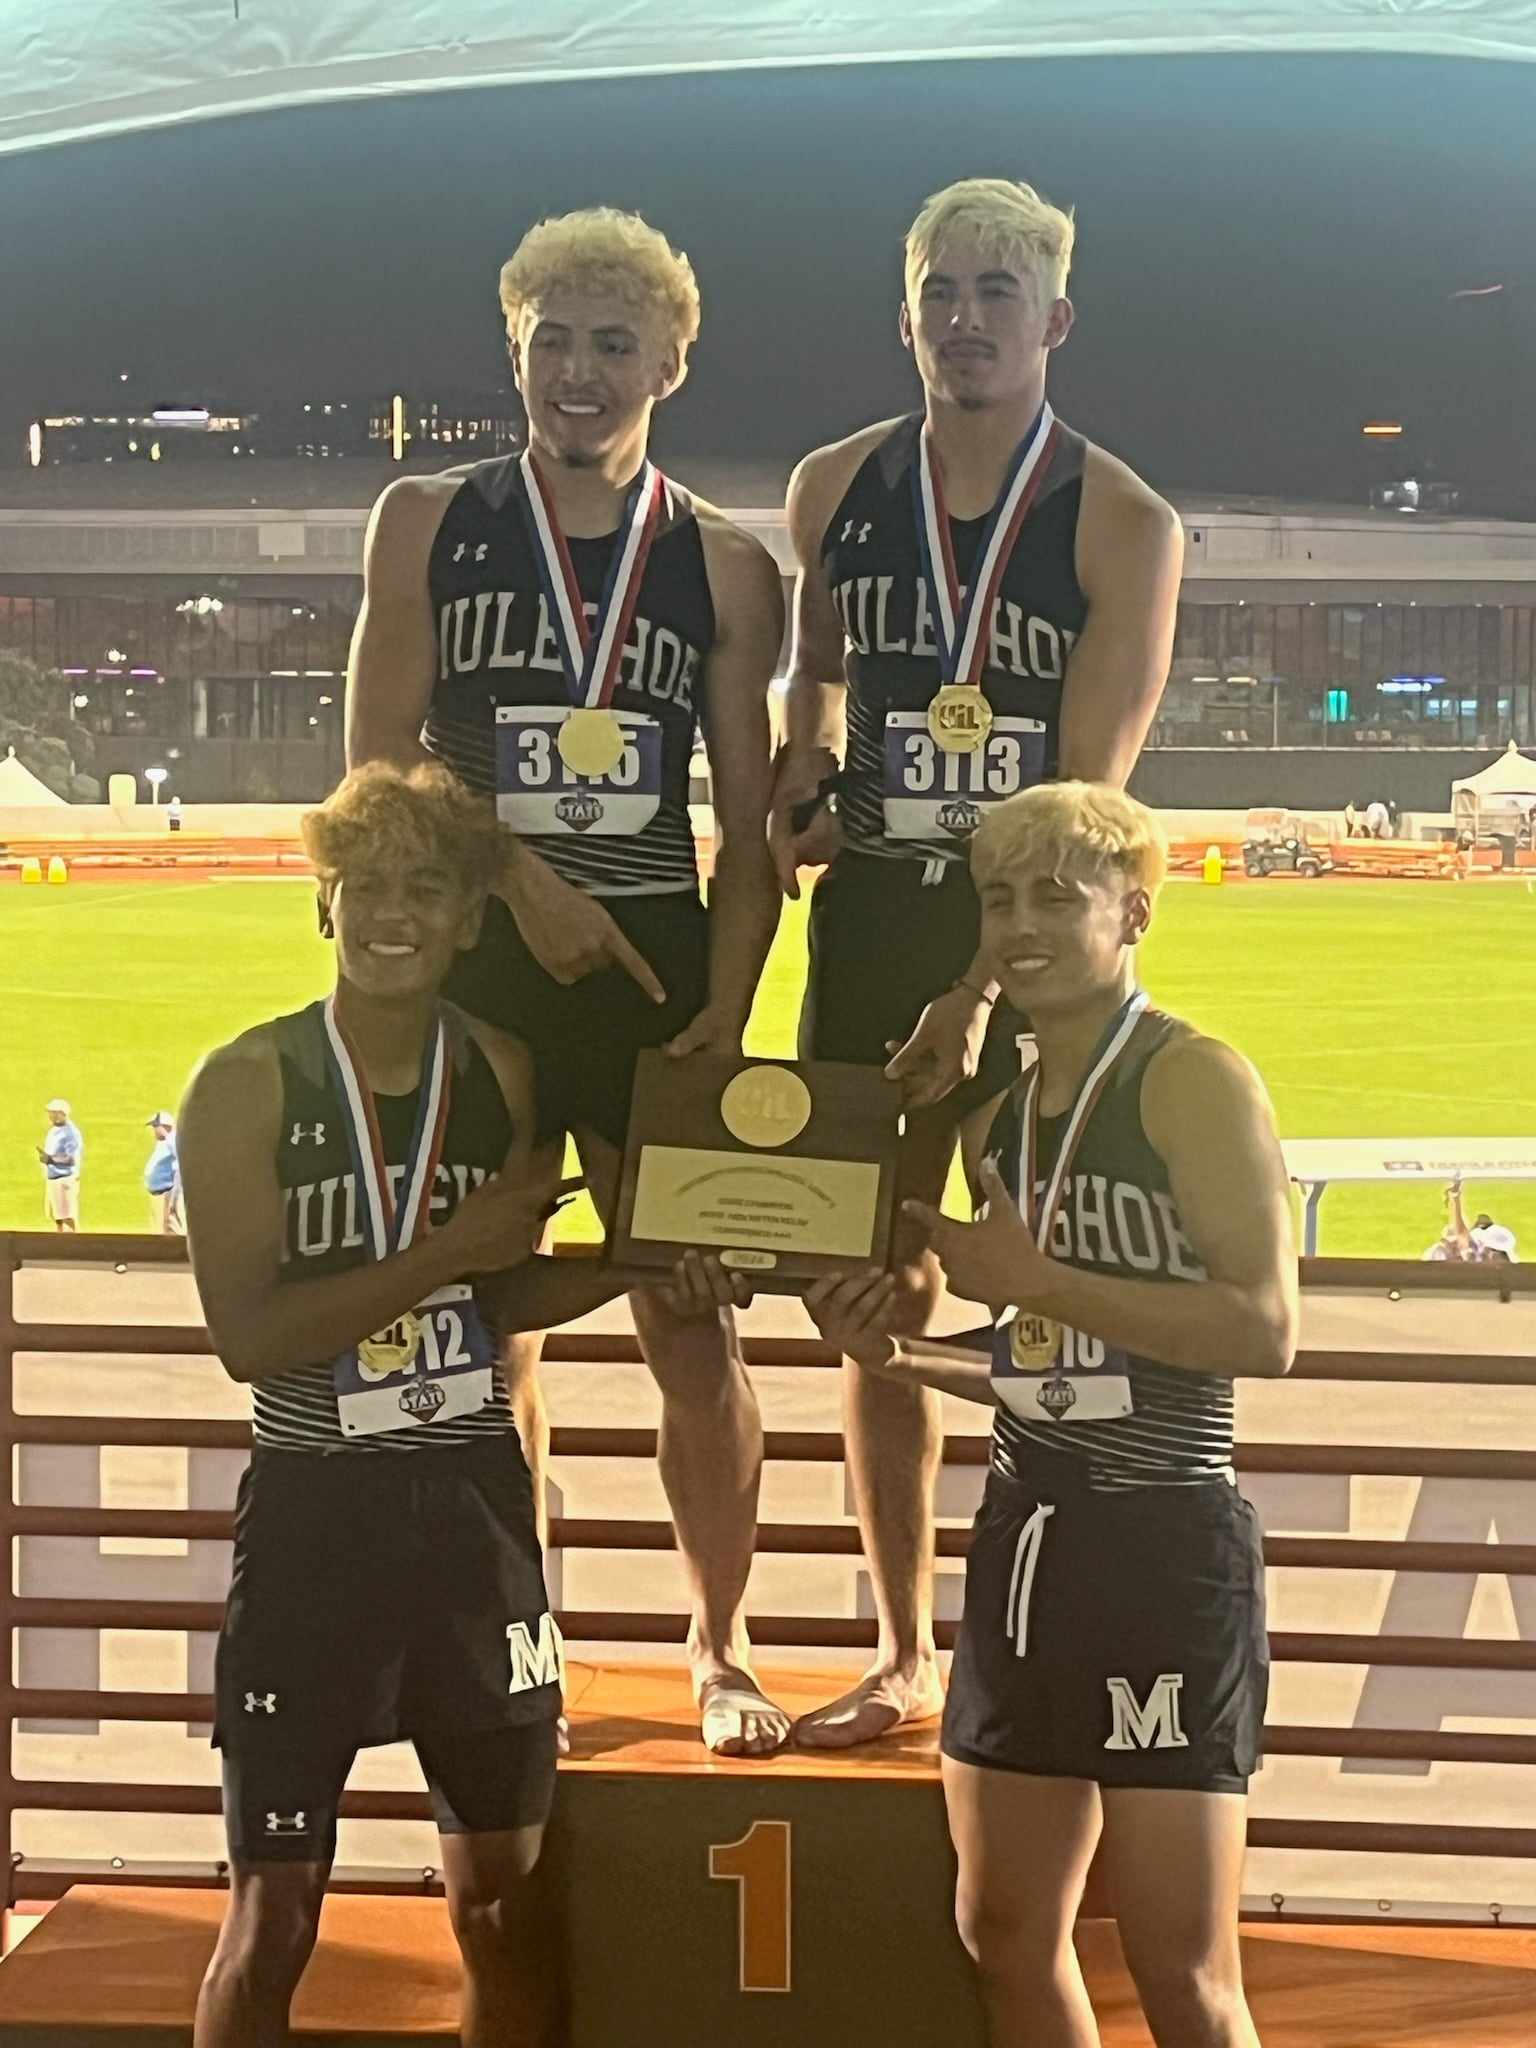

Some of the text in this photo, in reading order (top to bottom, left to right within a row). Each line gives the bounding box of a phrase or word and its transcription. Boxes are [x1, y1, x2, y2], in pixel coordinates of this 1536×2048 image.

[507, 1612, 564, 1694] M
[1103, 1673, 1190, 1751] M
[709, 1820, 791, 1992] 1
